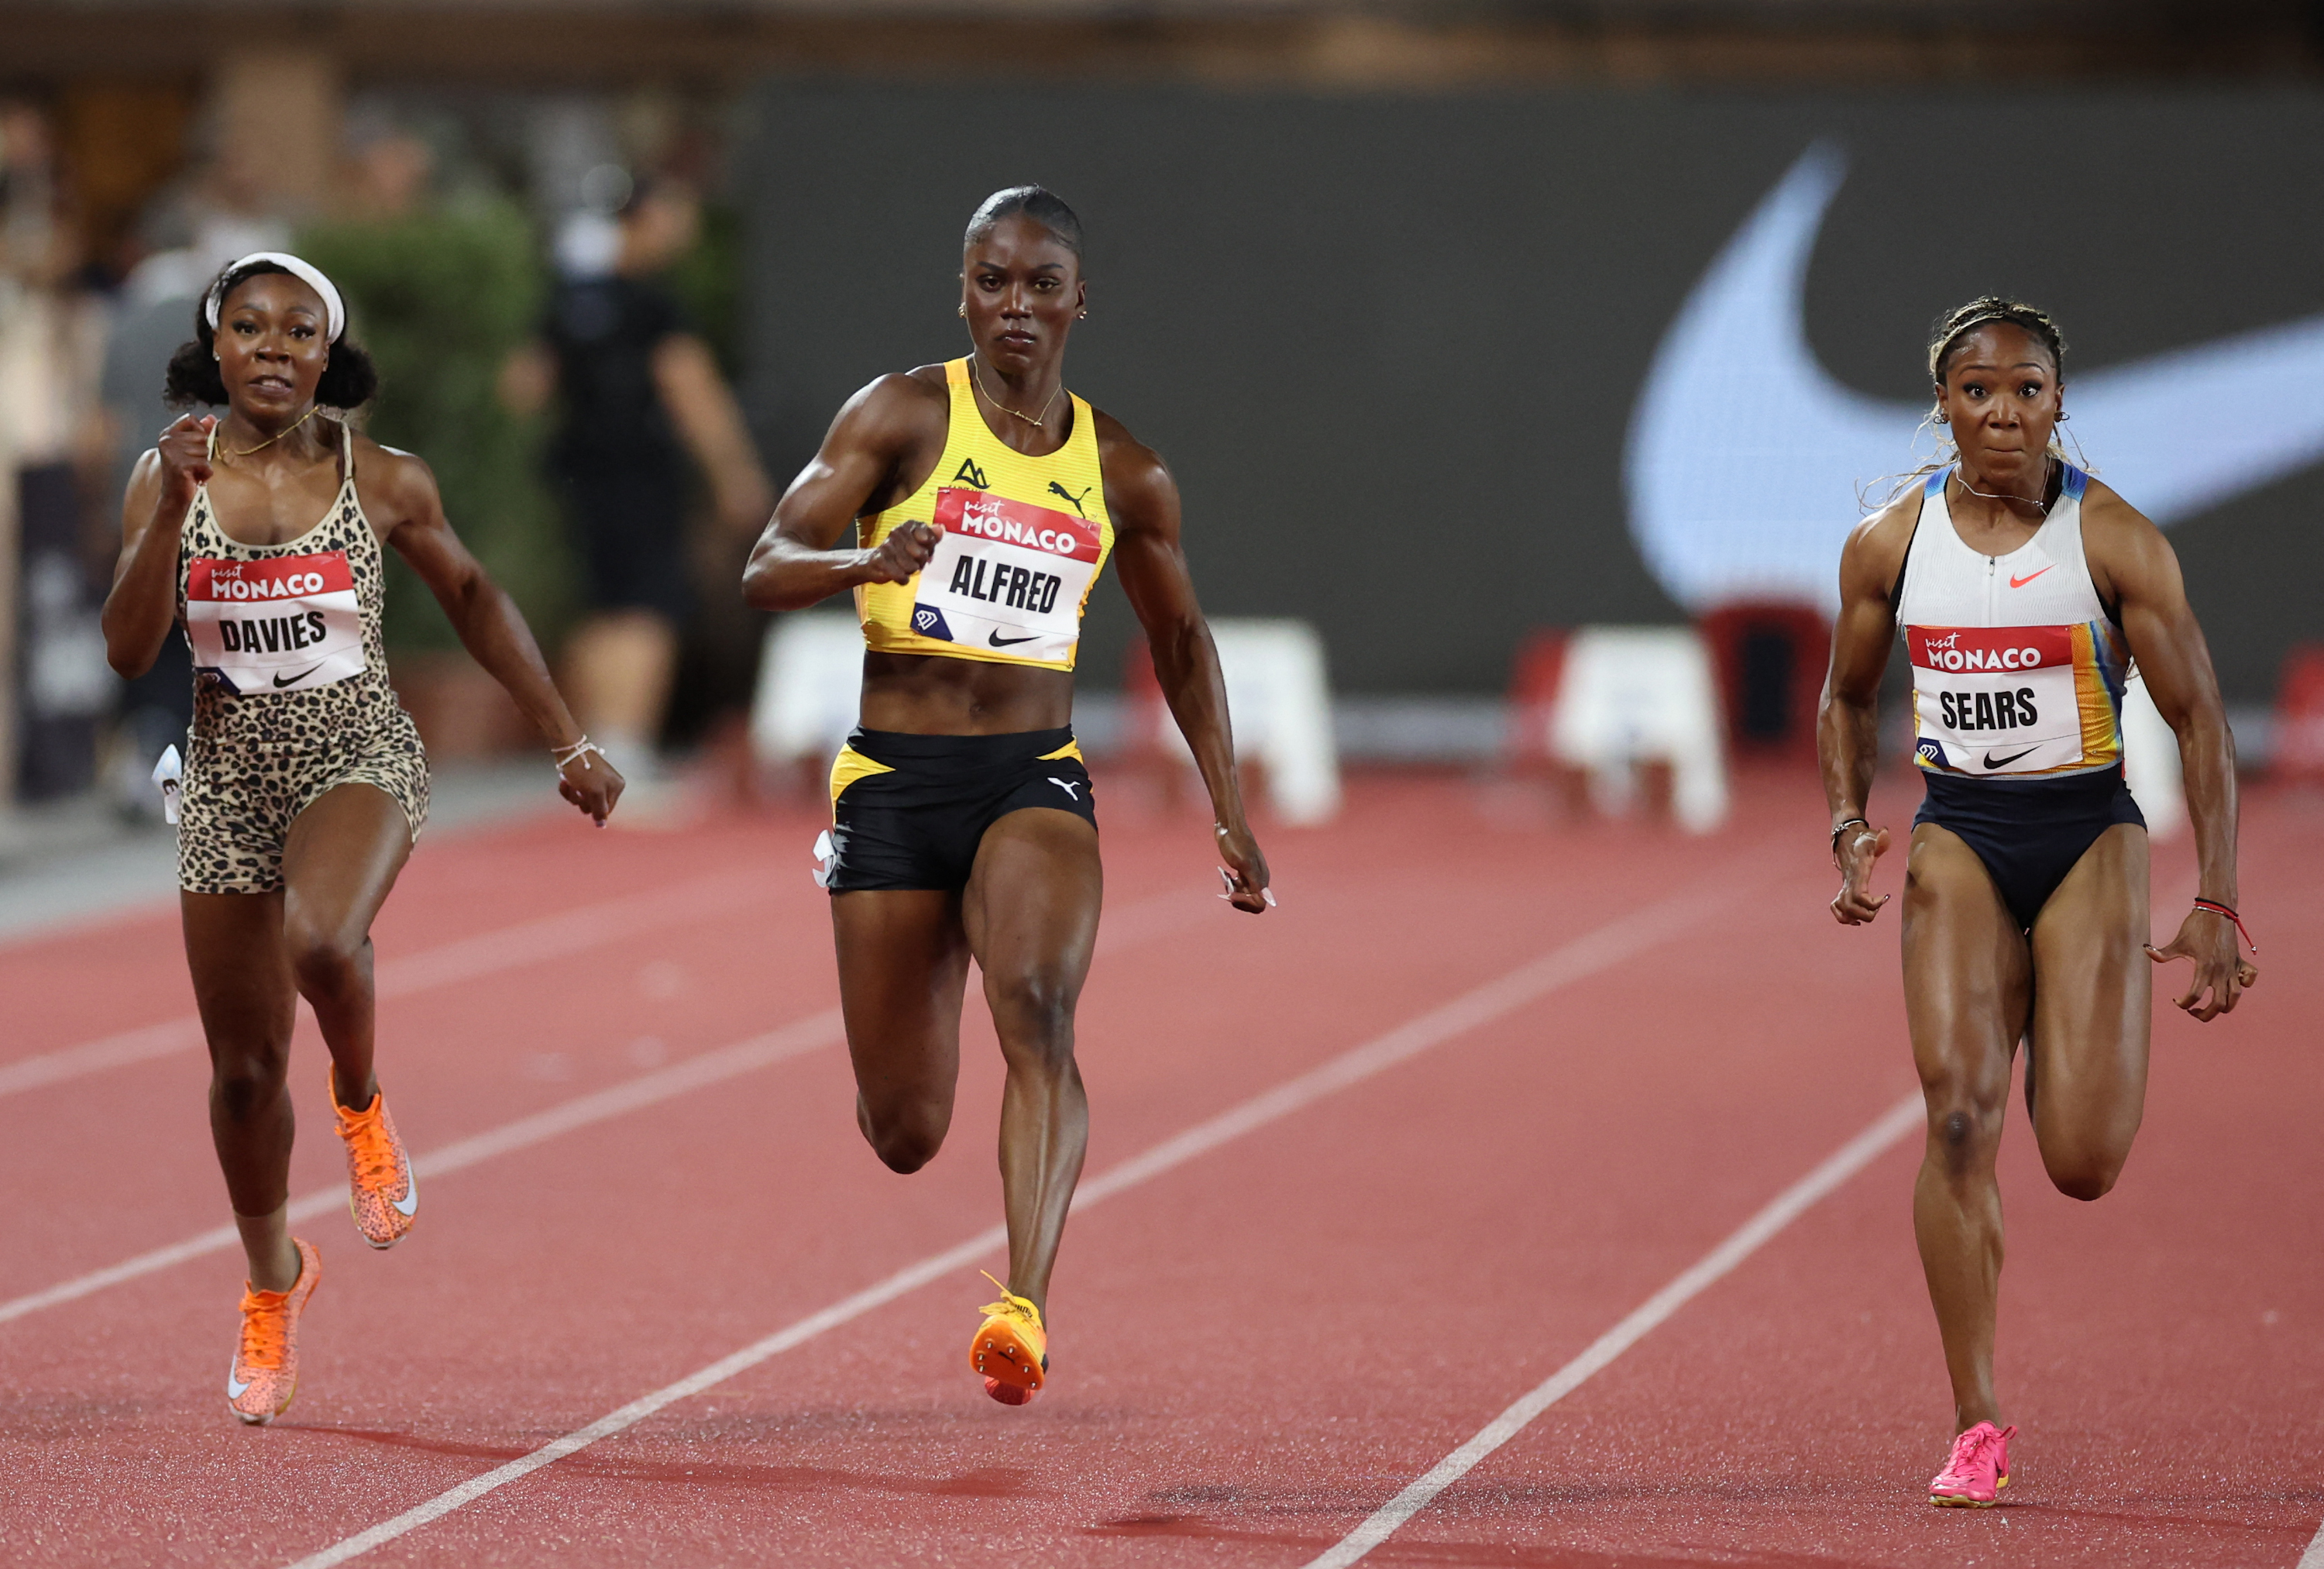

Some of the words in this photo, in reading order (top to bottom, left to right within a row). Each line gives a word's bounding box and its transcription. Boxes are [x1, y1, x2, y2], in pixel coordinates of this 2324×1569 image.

[964, 500, 1005, 517] visit
[961, 511, 1076, 554] MONACO
[211, 564, 244, 580] visit
[211, 572, 324, 599] MONACO
[949, 555, 1061, 614] ALFRED
[219, 611, 326, 653] DAVIES
[1925, 631, 1961, 649] visit
[1927, 647, 2041, 670] MONACO
[1940, 687, 2038, 730] SEARS
